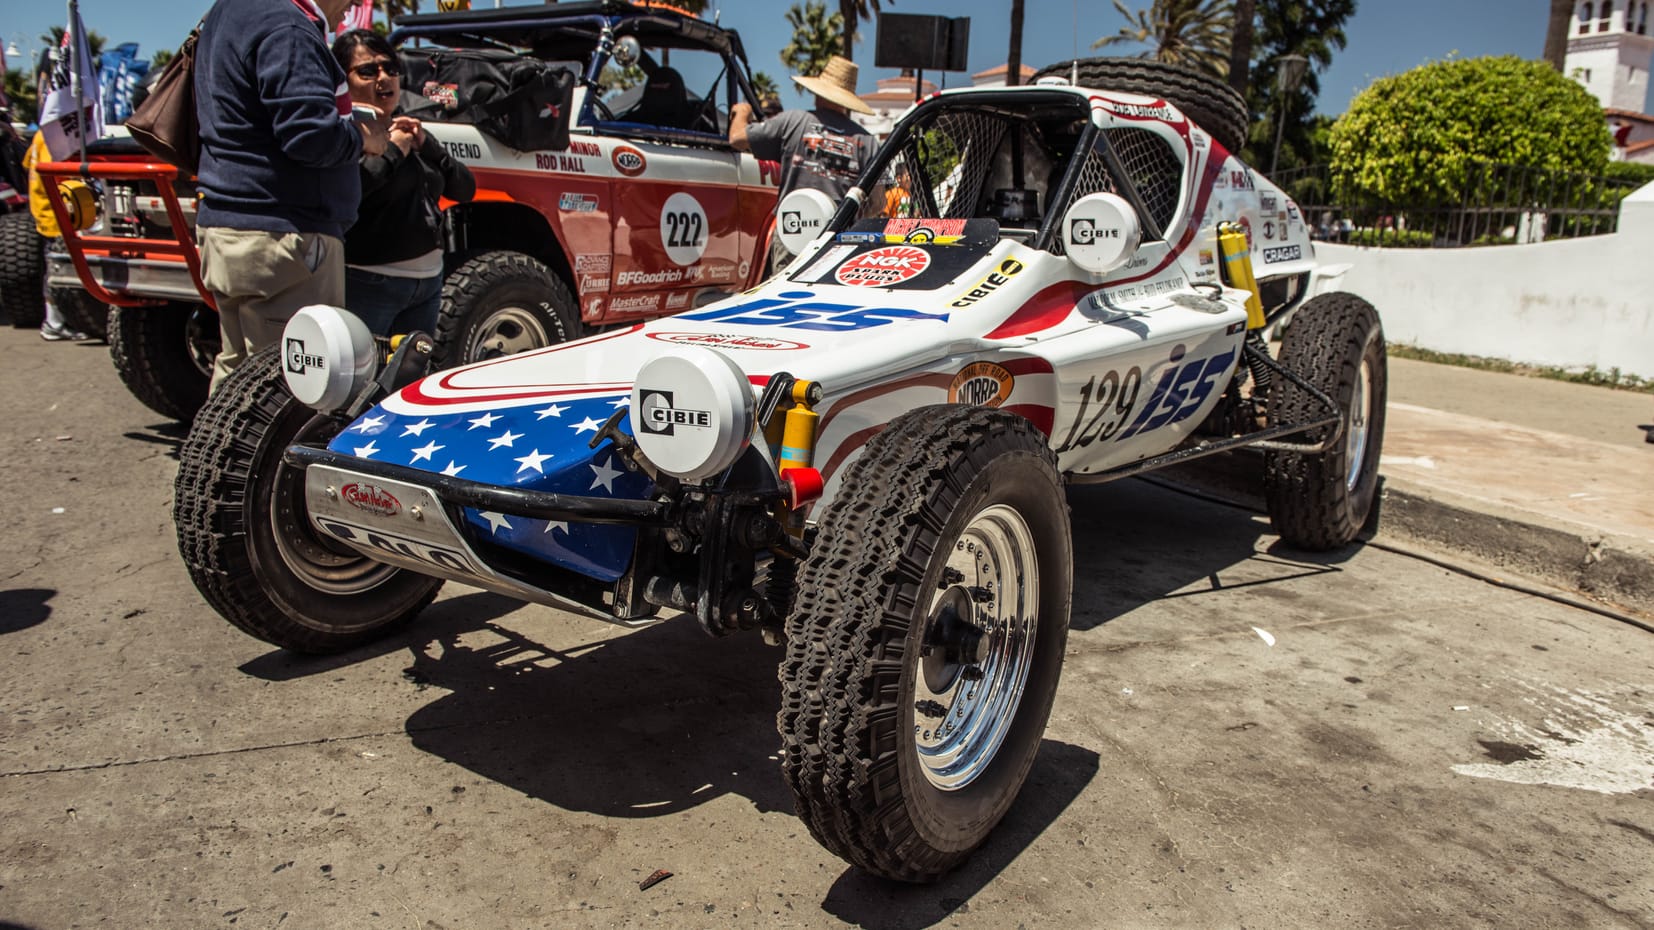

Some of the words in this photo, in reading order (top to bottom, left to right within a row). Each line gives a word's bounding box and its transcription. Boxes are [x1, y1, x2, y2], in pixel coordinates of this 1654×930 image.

[441, 142, 481, 159] TREND
[569, 141, 602, 157] MINOR
[535, 153, 557, 170] ROD
[560, 155, 586, 172] HALL
[667, 211, 703, 248] 222
[859, 255, 918, 268] NGK
[1264, 247, 1300, 264] CRAGAR
[616, 268, 683, 286] BFGoodrich
[845, 273, 896, 282] PLUGS
[851, 267, 902, 276] SPARK
[1056, 366, 1142, 453] 129
